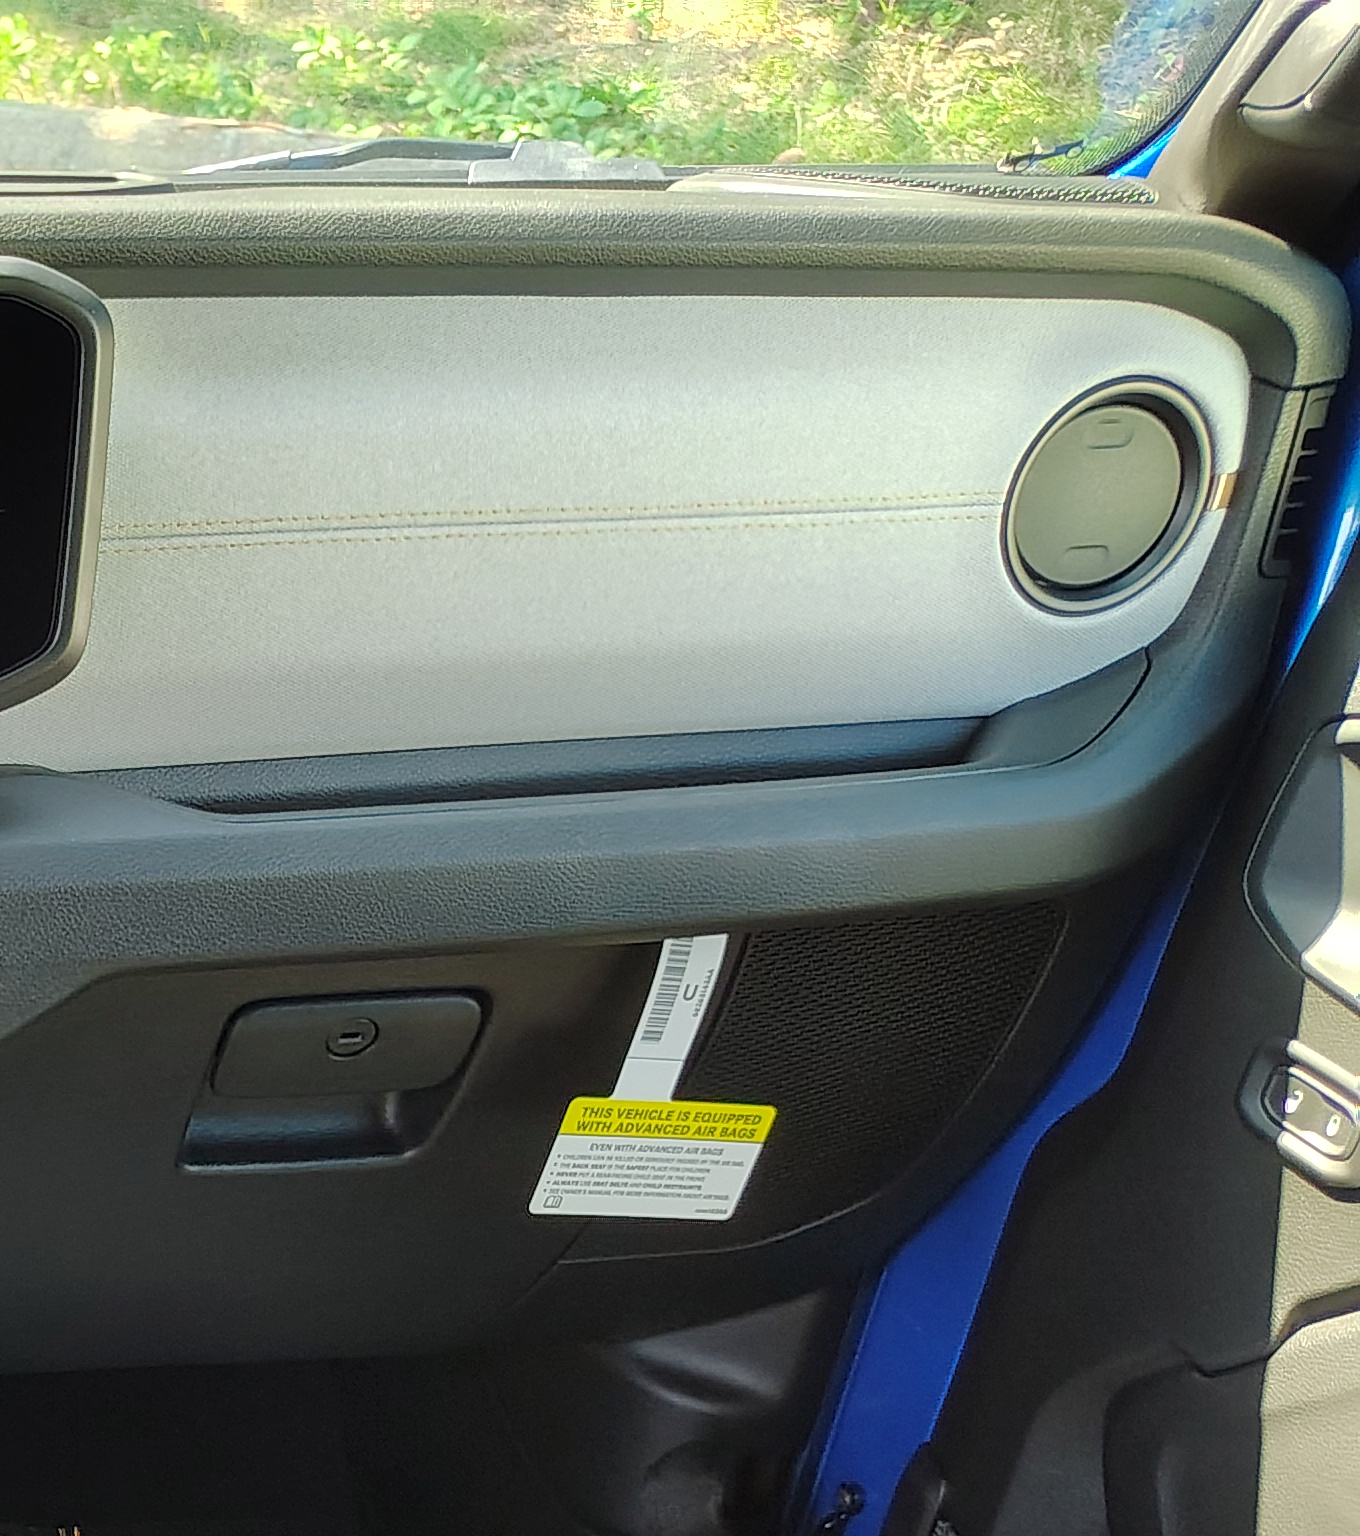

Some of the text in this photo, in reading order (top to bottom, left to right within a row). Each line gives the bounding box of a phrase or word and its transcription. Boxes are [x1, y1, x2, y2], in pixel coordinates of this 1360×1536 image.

[682, 984, 699, 1001] U
[581, 1106, 762, 1125] THIS VEHICLE IS EQUIPPED
[576, 1120, 757, 1139] WITH ADVANCED AIR BAGS
[589, 1142, 613, 1151] EVEN
[613, 1143, 637, 1152] WITH
